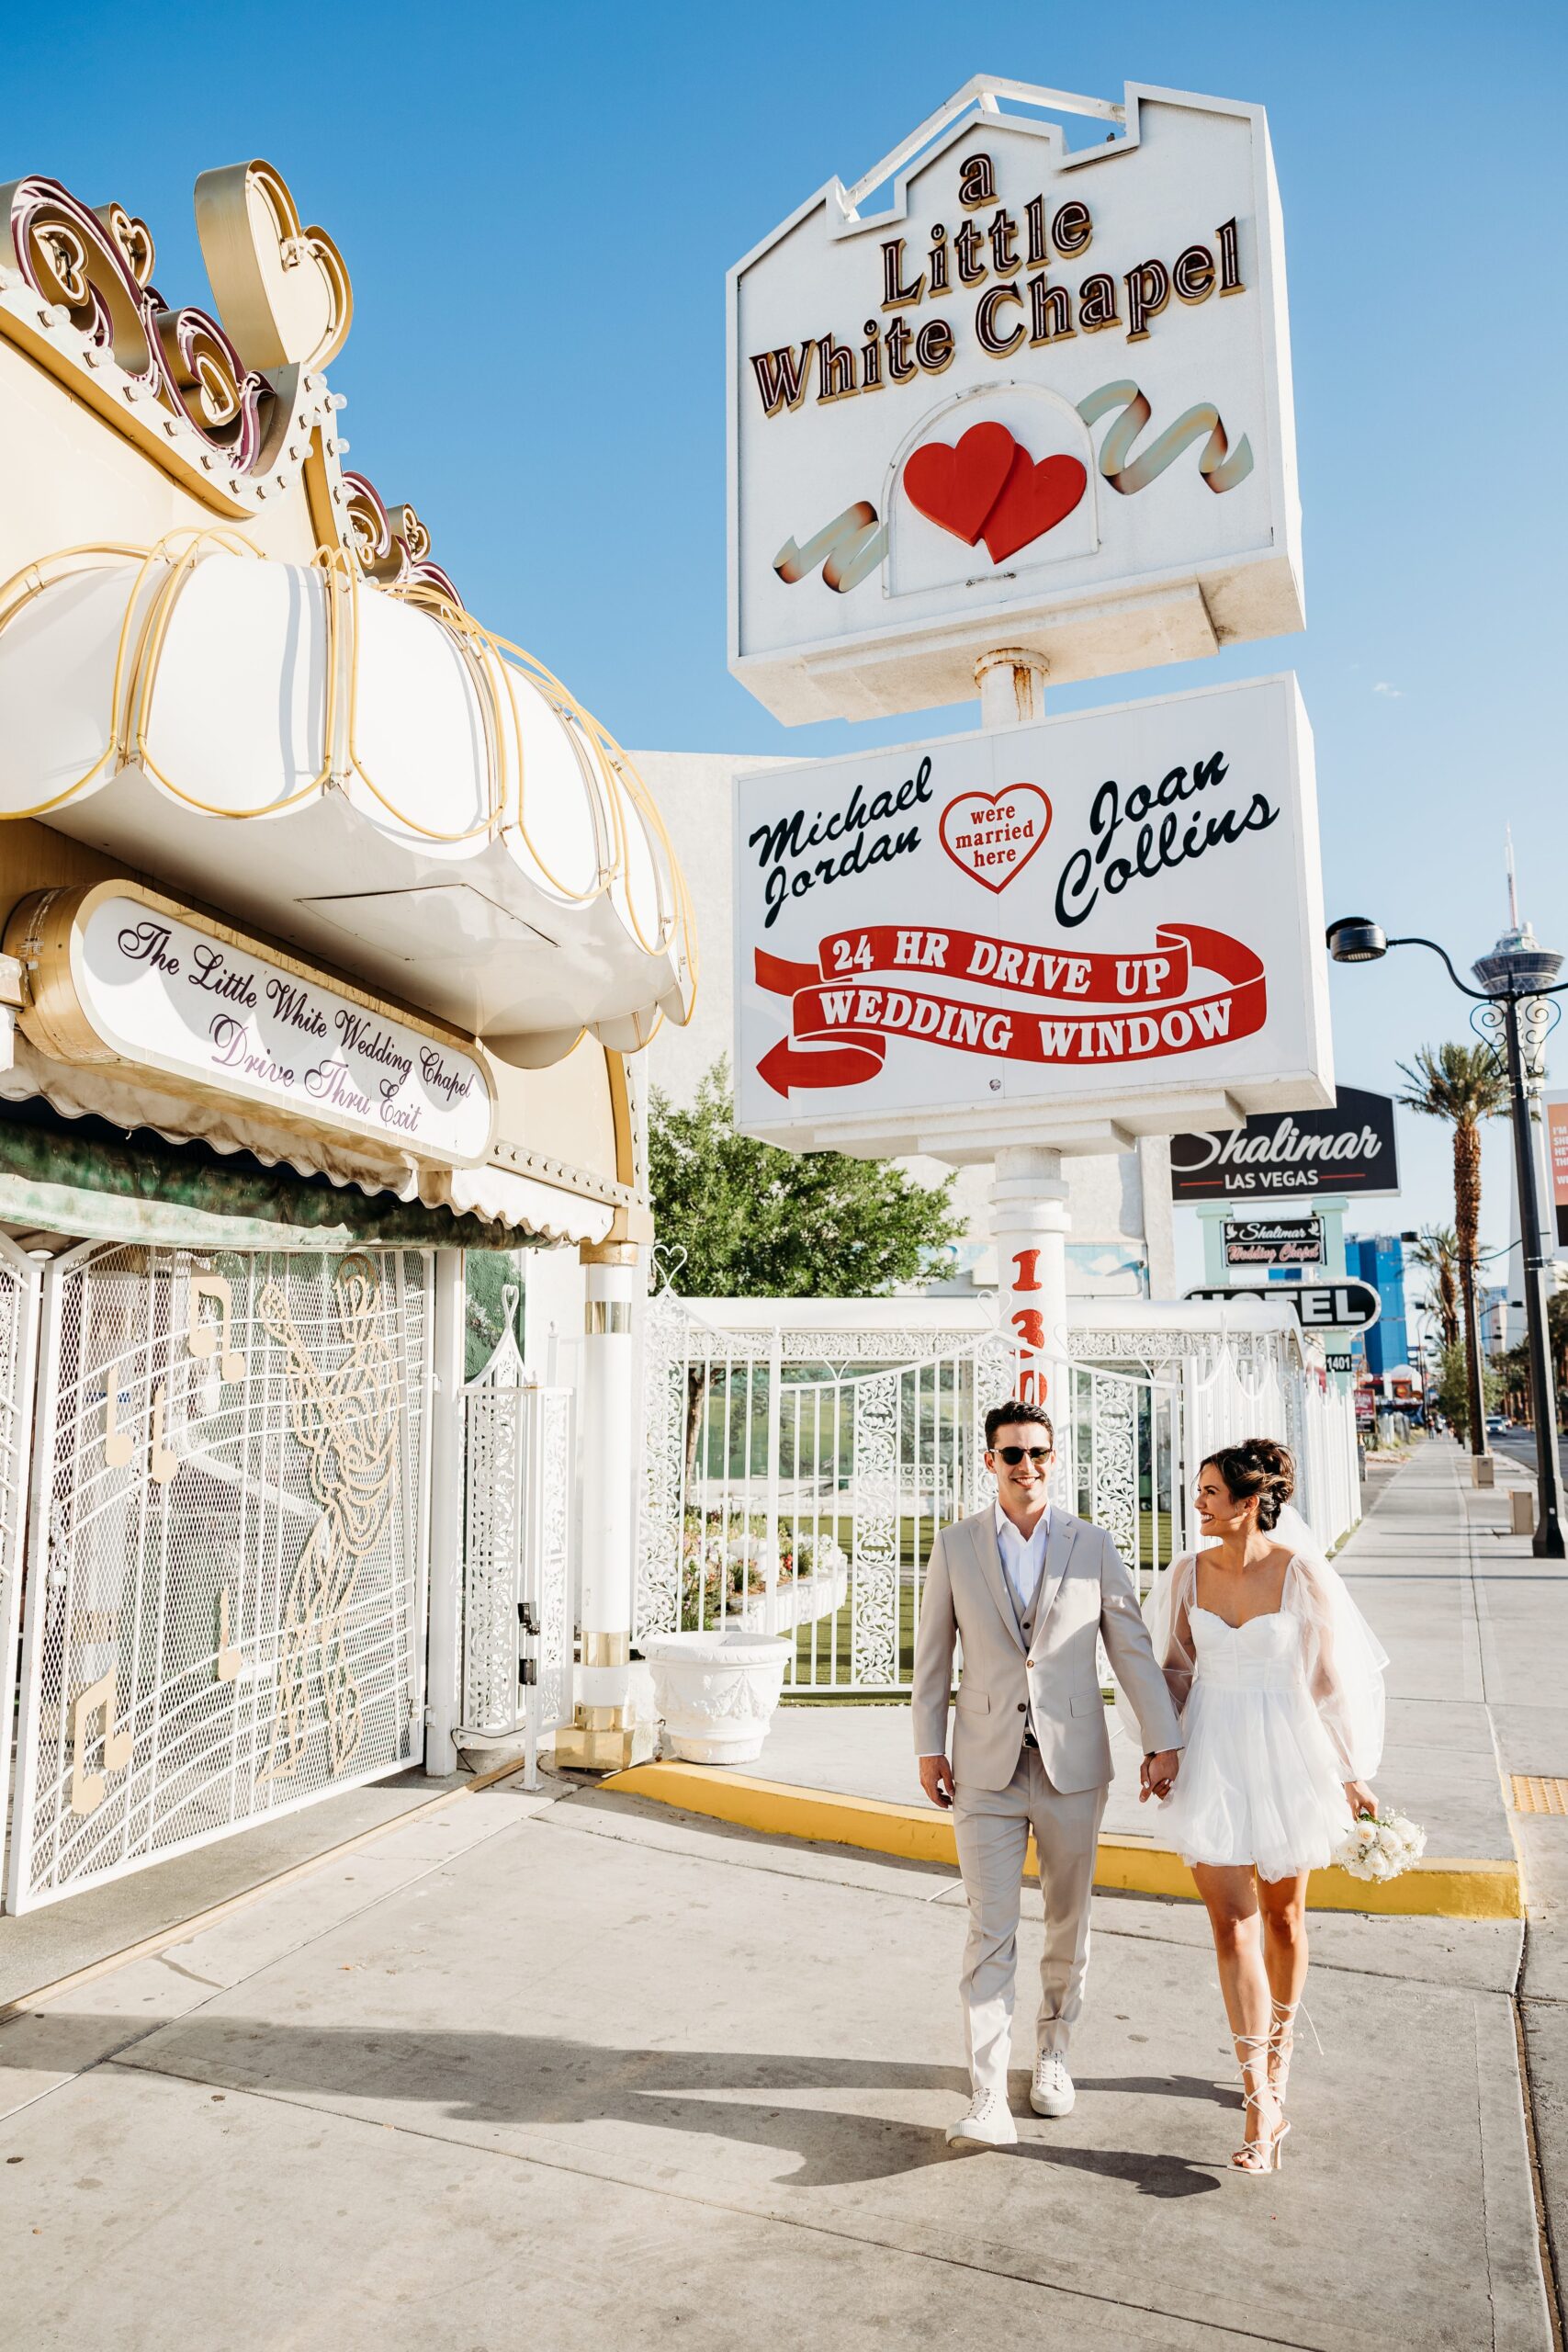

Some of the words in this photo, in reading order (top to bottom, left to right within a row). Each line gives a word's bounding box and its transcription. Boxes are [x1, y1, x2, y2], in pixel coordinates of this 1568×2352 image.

[959, 153, 999, 210] a
[879, 193, 1092, 311] Little
[750, 316, 955, 418] White
[976, 216, 1246, 358] Chapel
[749, 755, 933, 867] Michael
[955, 820, 1034, 849] married
[970, 803, 1016, 825] were
[1089, 750, 1230, 864] Joan
[764, 825, 922, 928] Jordan
[973, 847, 1017, 868] here
[1055, 793, 1280, 928] Collins
[832, 933, 874, 971] 24
[896, 931, 947, 969] HR
[966, 940, 1093, 996] DRIVE
[1115, 958, 1171, 996] UP
[118, 922, 179, 976] The
[188, 944, 257, 1008] Little
[266, 978, 327, 1038] White
[334, 1009, 412, 1083] Wedding
[420, 1046, 472, 1102] Chapel
[818, 989, 1013, 1052] WEDDING
[1038, 999, 1234, 1058] WINDOW
[209, 1013, 294, 1088] Drive
[304, 1059, 370, 1114] Thru
[379, 1079, 423, 1133] Exit
[1224, 1173, 1256, 1190] LAS
[1259, 1170, 1319, 1187] VEGAS
[1239, 1223, 1306, 1240] Shalimar
[1326, 1355, 1351, 1370] 1401
